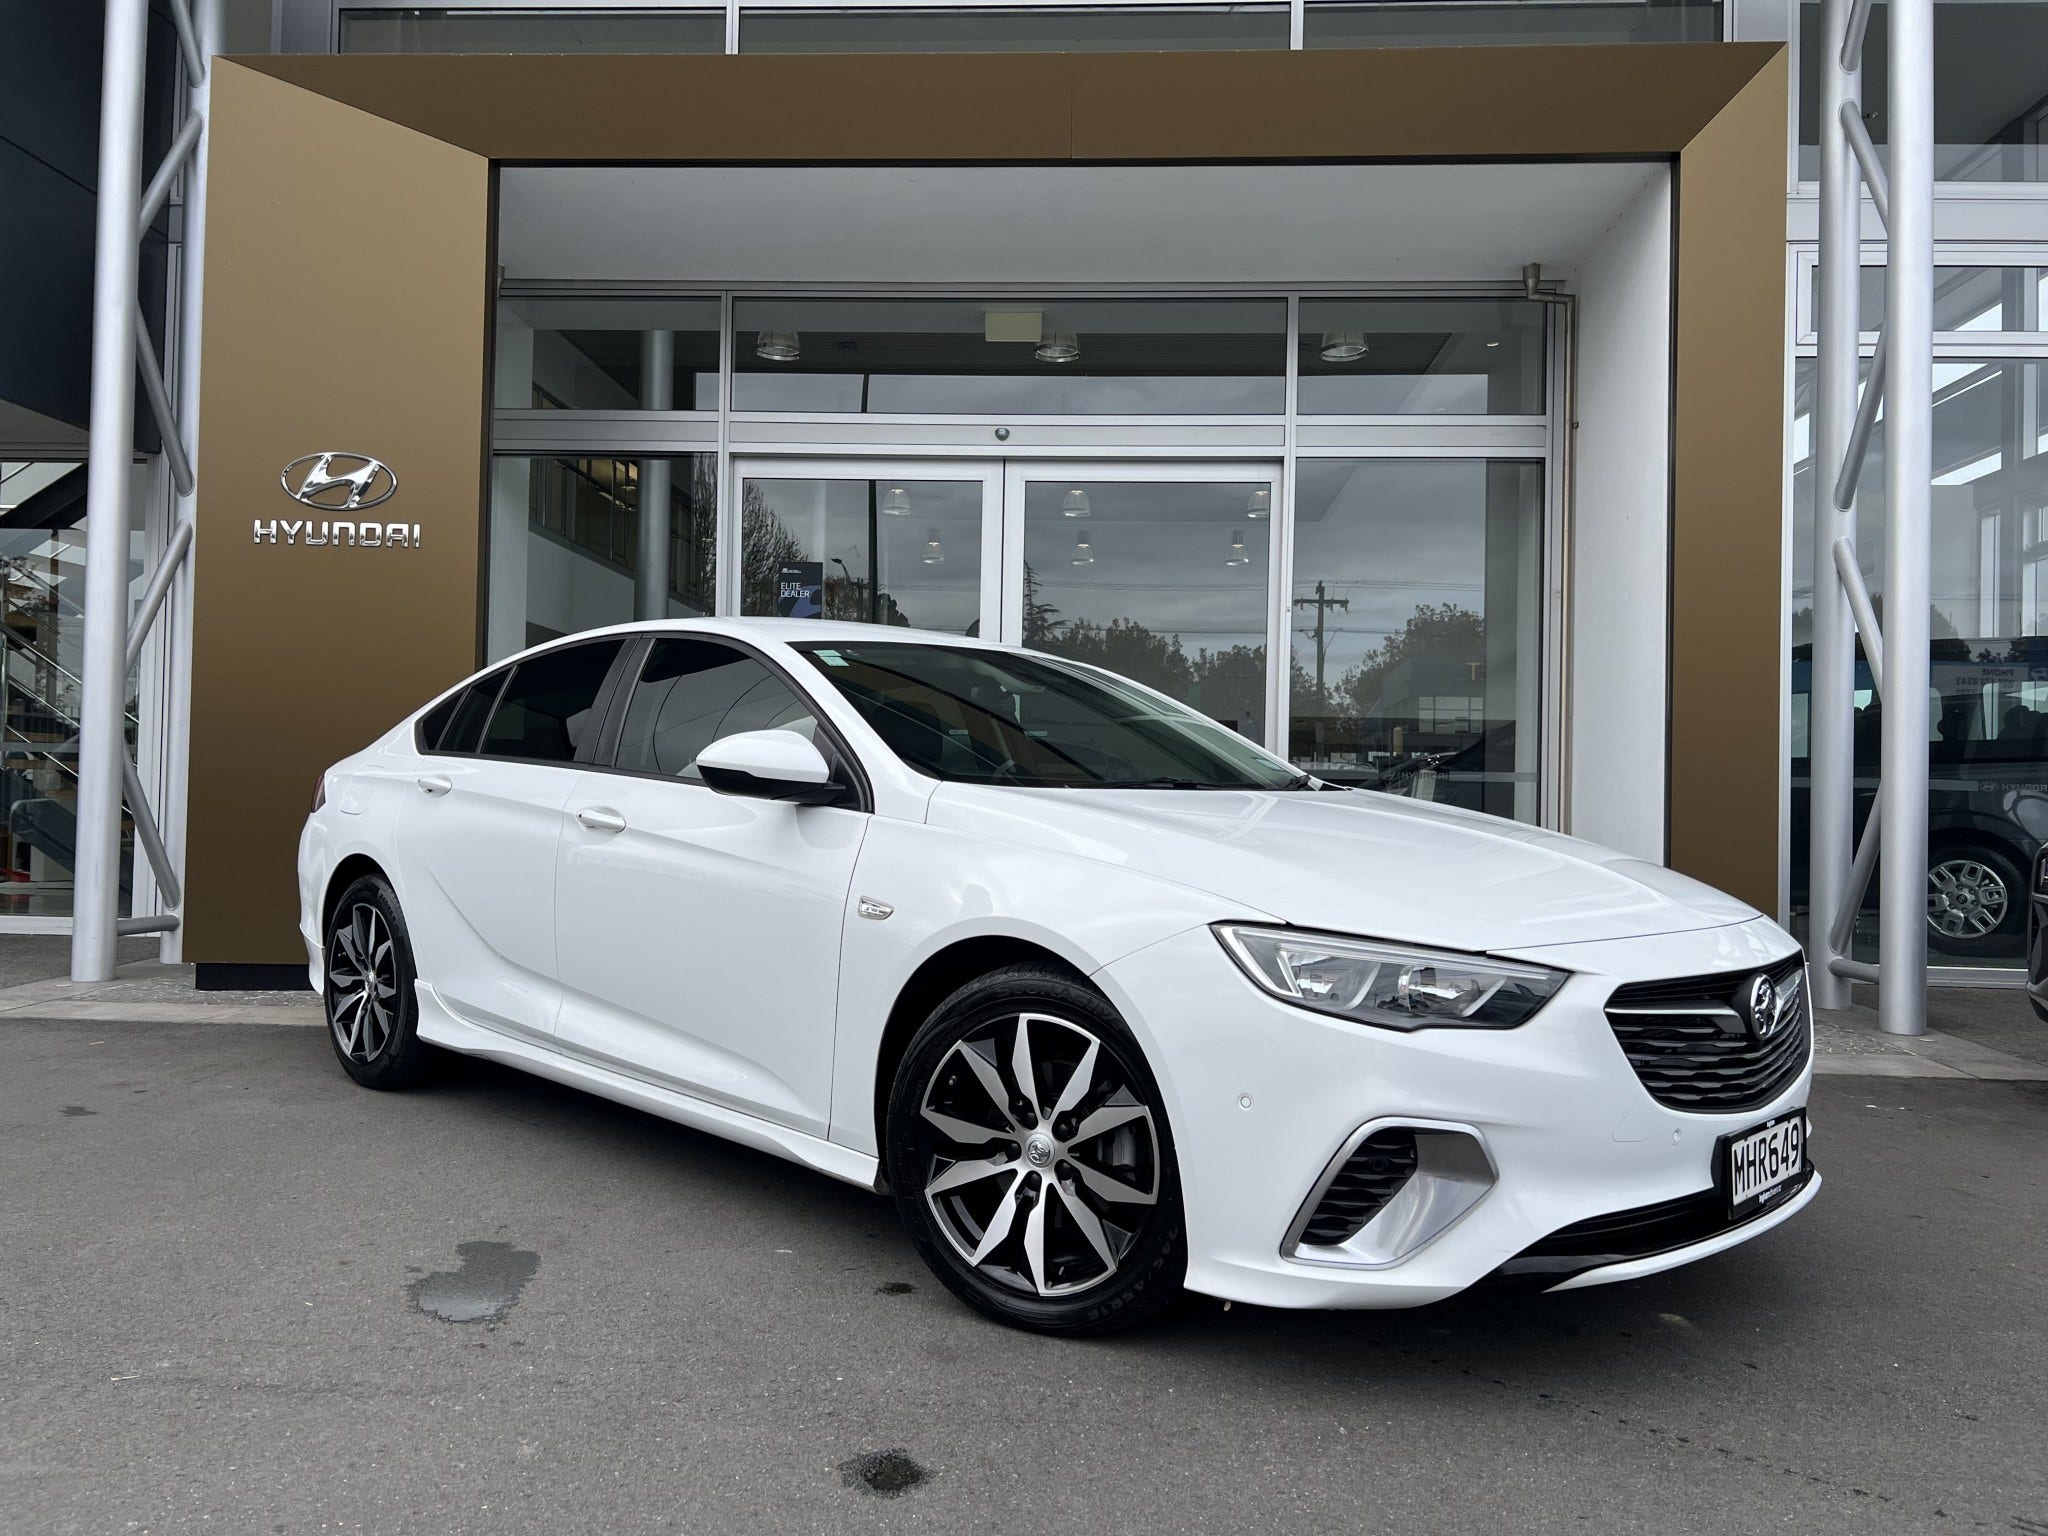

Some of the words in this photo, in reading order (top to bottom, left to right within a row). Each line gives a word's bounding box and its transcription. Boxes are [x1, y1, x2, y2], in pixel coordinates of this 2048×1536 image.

[253, 519, 421, 548] HYUNDAI
[780, 582, 802, 590] ELITE
[780, 590, 810, 598] DEALER
[1734, 1122, 1799, 1195] MHR649
